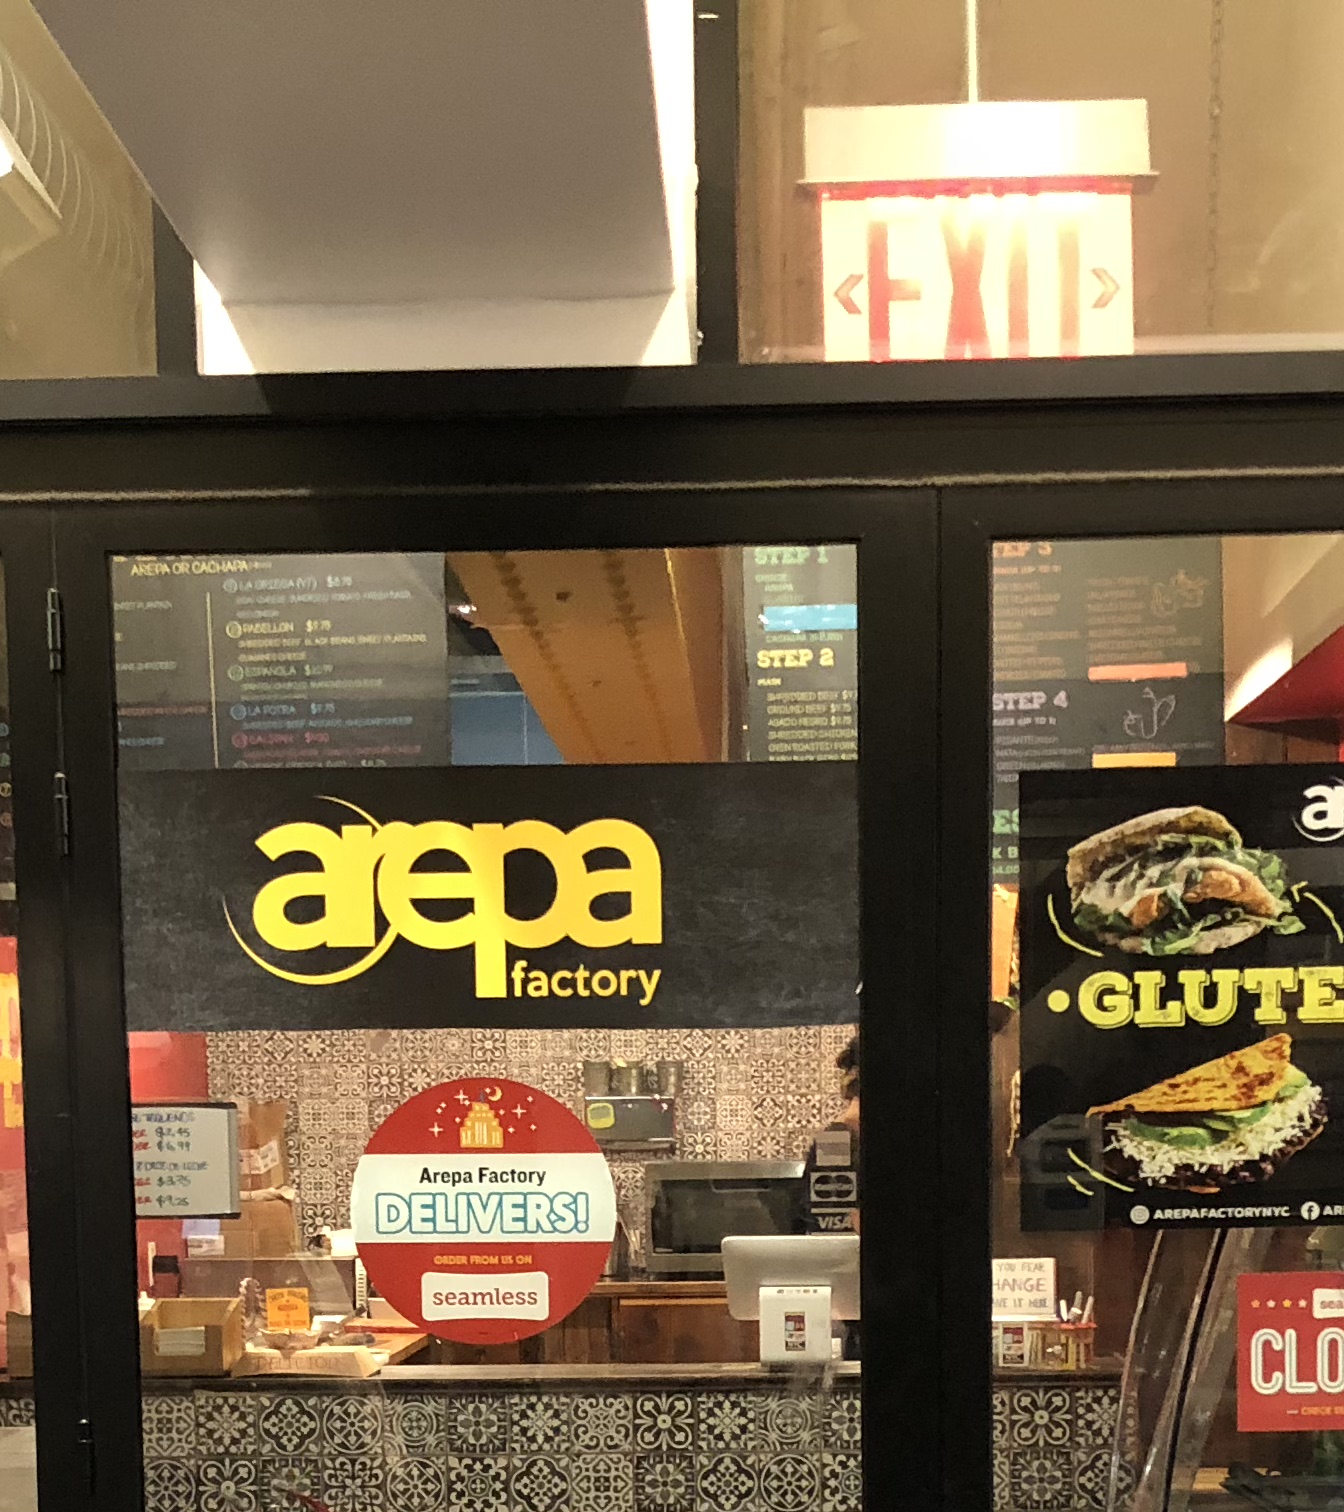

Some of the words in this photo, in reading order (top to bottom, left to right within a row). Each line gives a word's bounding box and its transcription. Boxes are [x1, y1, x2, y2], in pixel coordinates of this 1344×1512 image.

[757, 649, 813, 668] STEP
[819, 648, 834, 667] 2
[993, 691, 1047, 710] STEP
[1053, 690, 1068, 708] 4
[253, 818, 663, 998] arepa
[511, 959, 662, 1006] factory
[419, 1167, 473, 1187] Arepa
[478, 1166, 546, 1187] Factory
[375, 1192, 590, 1234] DELIVERS!
[818, 1215, 853, 1230] VISA
[1153, 1205, 1291, 1220] AREPAFACTORYNYC
[433, 1255, 468, 1265] ORDER
[469, 1255, 499, 1264] FROM
[501, 1255, 514, 1264] US
[515, 1255, 532, 1264] ON
[432, 1287, 538, 1306] seamless
